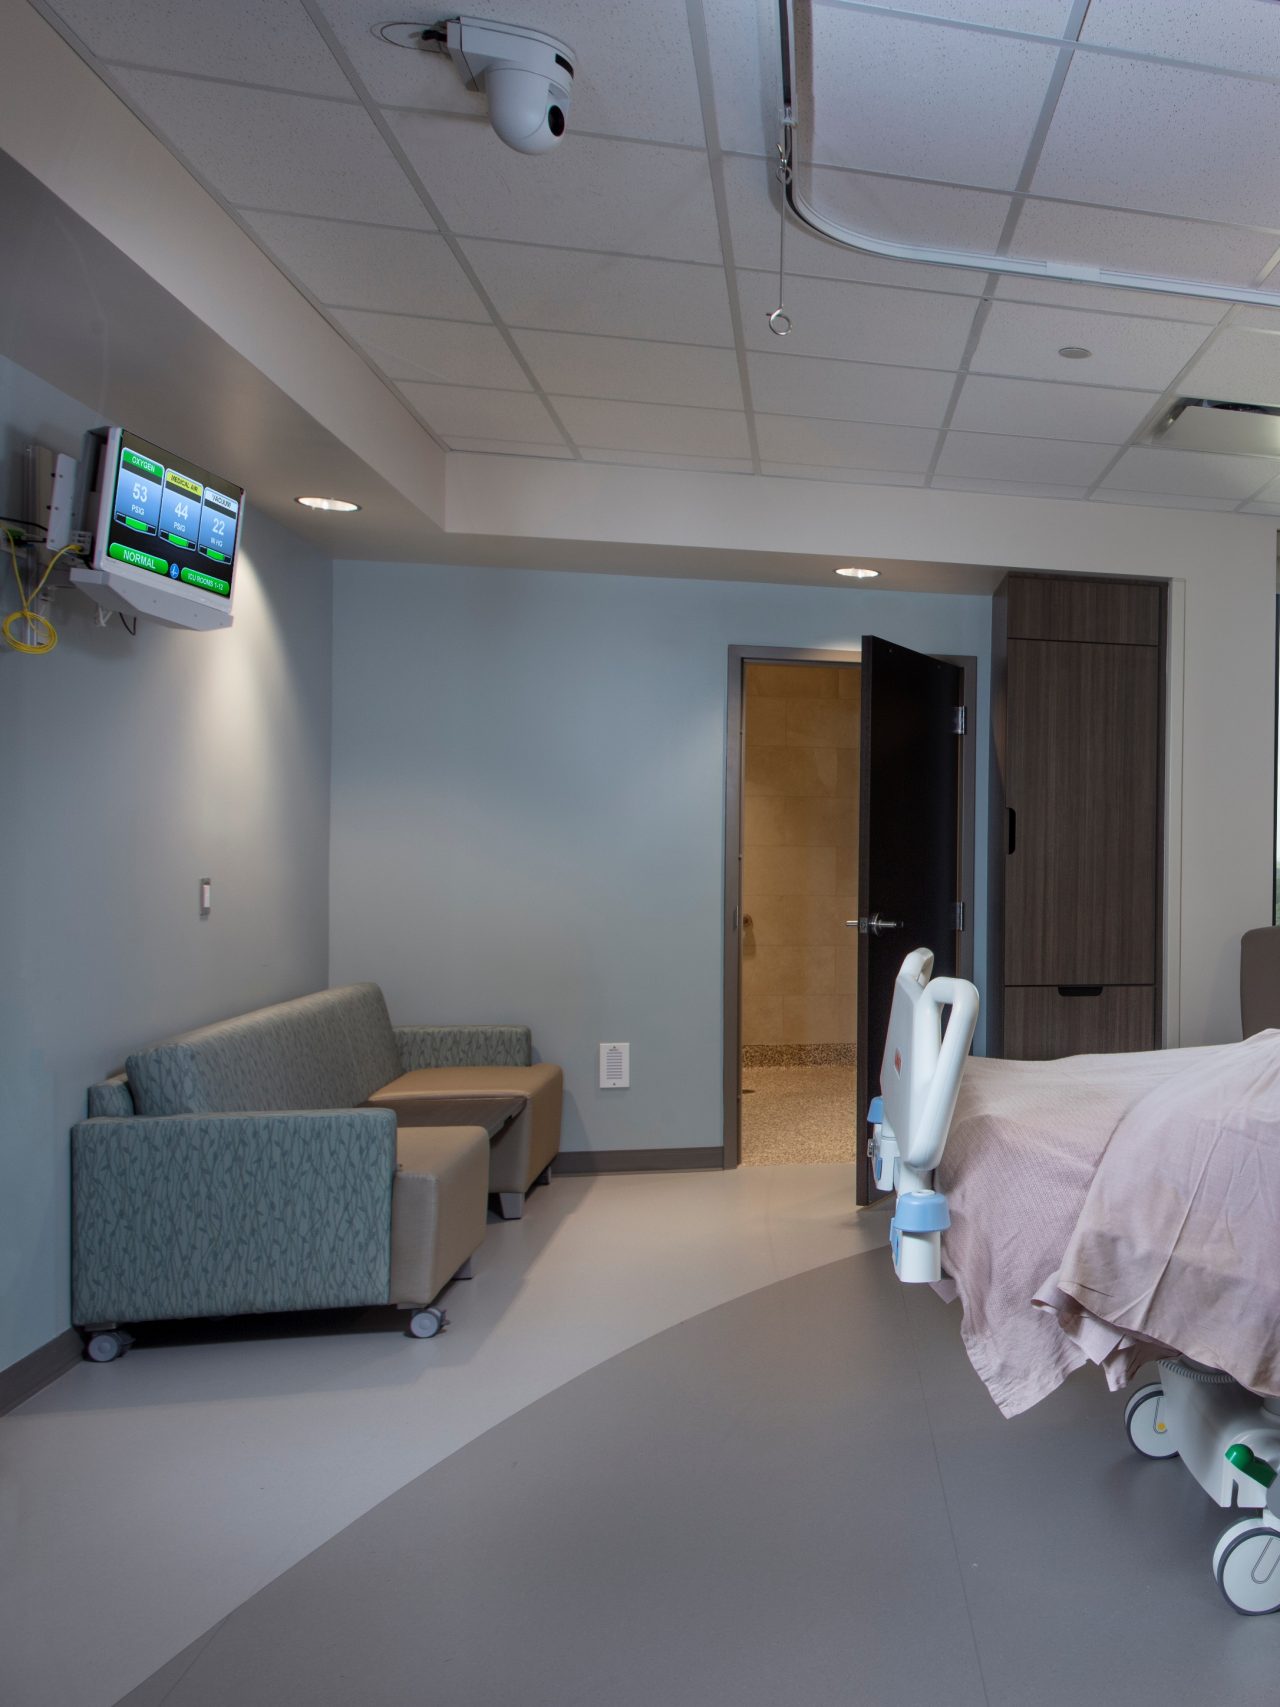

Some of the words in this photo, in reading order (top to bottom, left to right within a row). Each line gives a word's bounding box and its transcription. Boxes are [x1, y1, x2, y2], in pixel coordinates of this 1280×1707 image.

[132, 456, 155, 472] OXYGEN
[170, 474, 189, 489] MEDICAL
[132, 482, 148, 503] 53
[131, 504, 145, 516] PSIG
[174, 502, 189, 520] 44
[173, 521, 186, 532] PSIG
[212, 517, 225, 536] 22
[123, 549, 156, 570] NORMAL
[187, 573, 197, 581] ICU
[197, 575, 214, 587] ROOMS
[214, 581, 224, 591] 1-12
